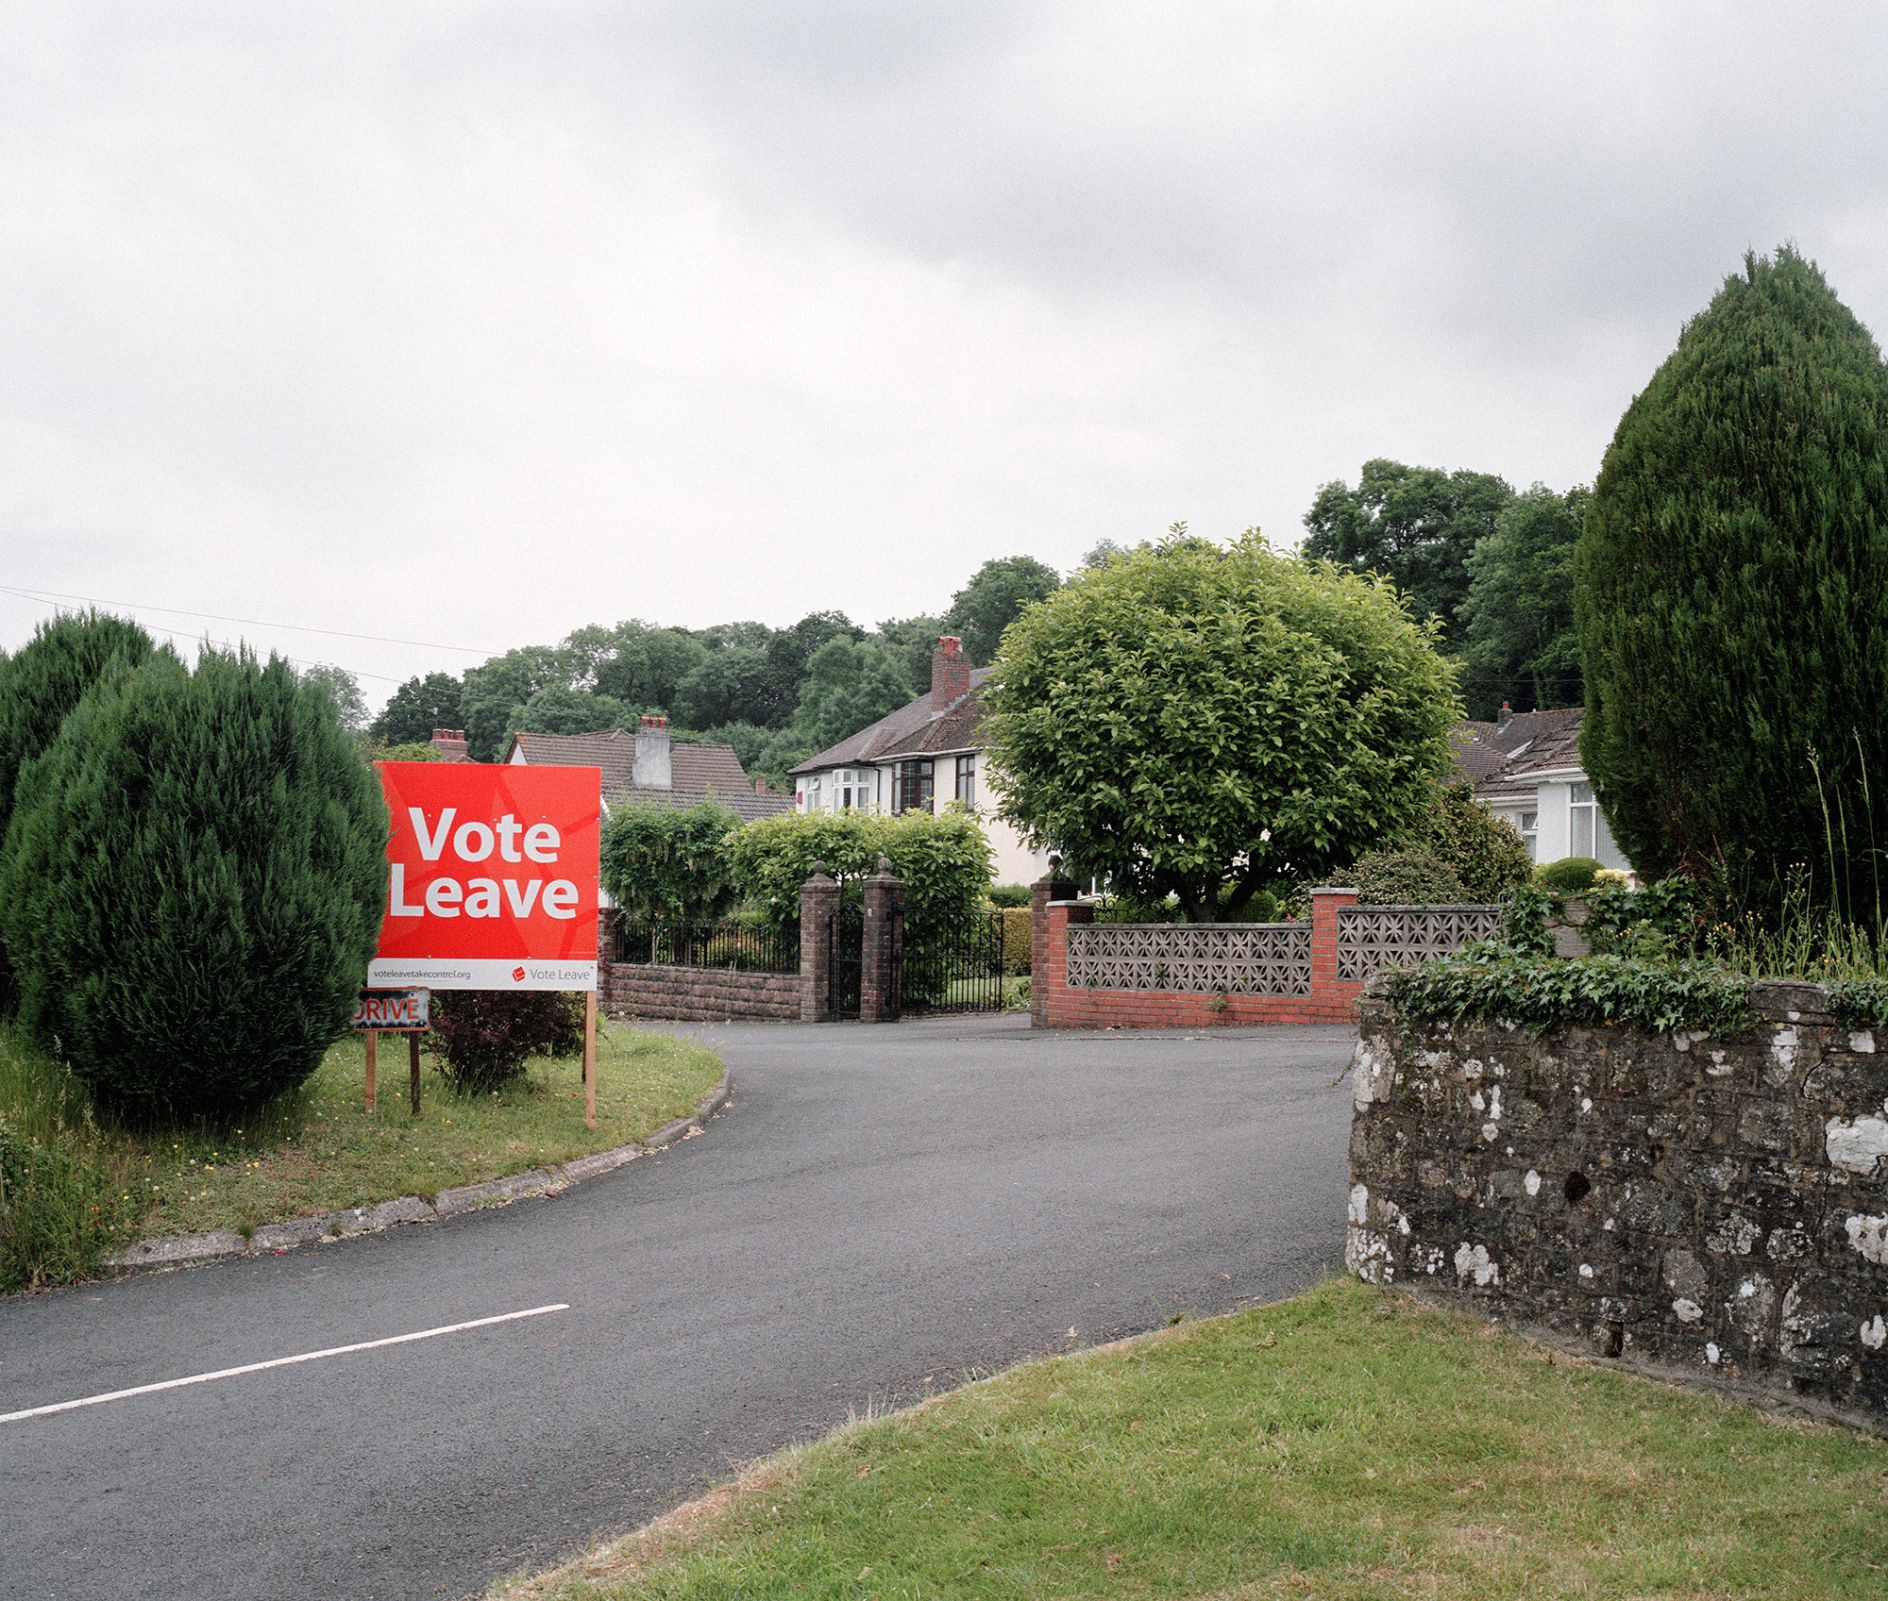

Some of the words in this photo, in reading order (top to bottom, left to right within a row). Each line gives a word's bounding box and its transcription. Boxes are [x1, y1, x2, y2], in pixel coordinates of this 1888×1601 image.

[408, 807, 561, 863] Vote
[390, 863, 579, 919] Leave
[373, 970, 471, 980] voteleavetakecontrol.org
[530, 968, 555, 980] Vote
[558, 969, 590, 980] Leave
